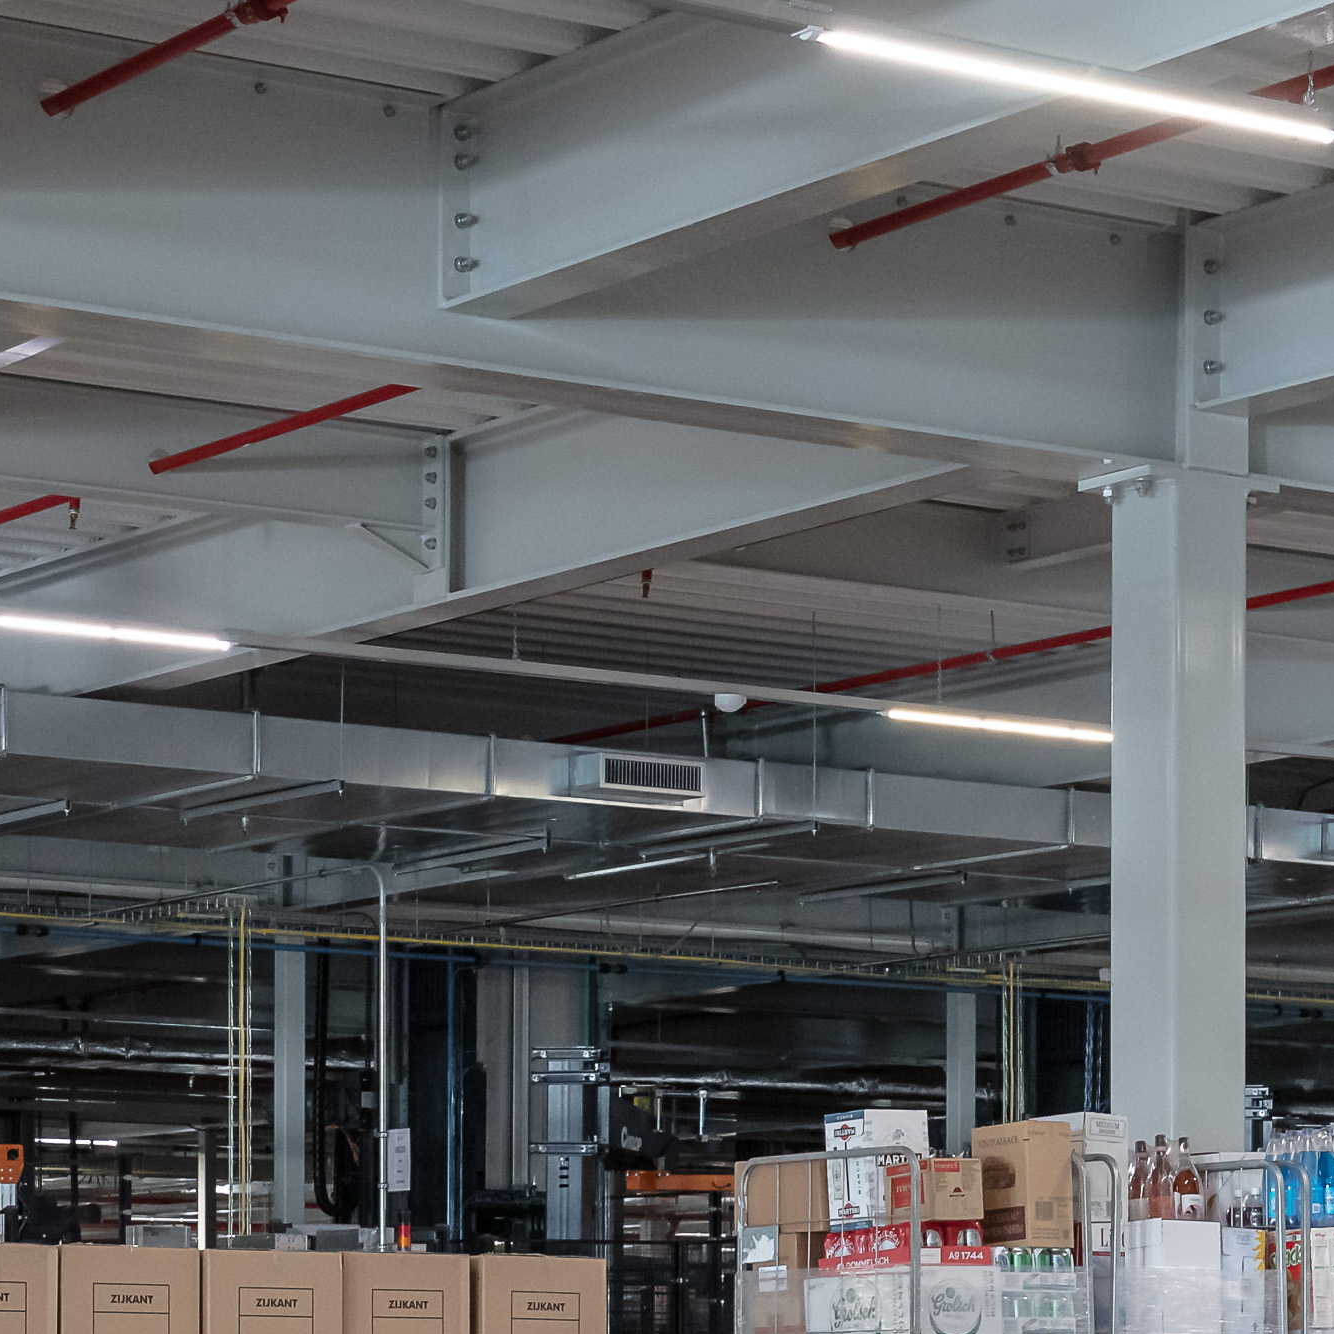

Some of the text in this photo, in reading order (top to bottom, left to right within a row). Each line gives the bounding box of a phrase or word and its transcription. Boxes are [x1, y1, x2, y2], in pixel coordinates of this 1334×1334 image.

[1096, 1120, 1120, 1130] MEDIUM
[961, 1251, 984, 1260] 1744
[110, 1294, 153, 1304] ZIJKANT
[256, 1298, 298, 1308] ZIJKANT
[388, 1300, 428, 1310] ZIJKANT
[527, 1302, 566, 1312] ZIJKANT
[932, 1295, 976, 1316] Grolsch
